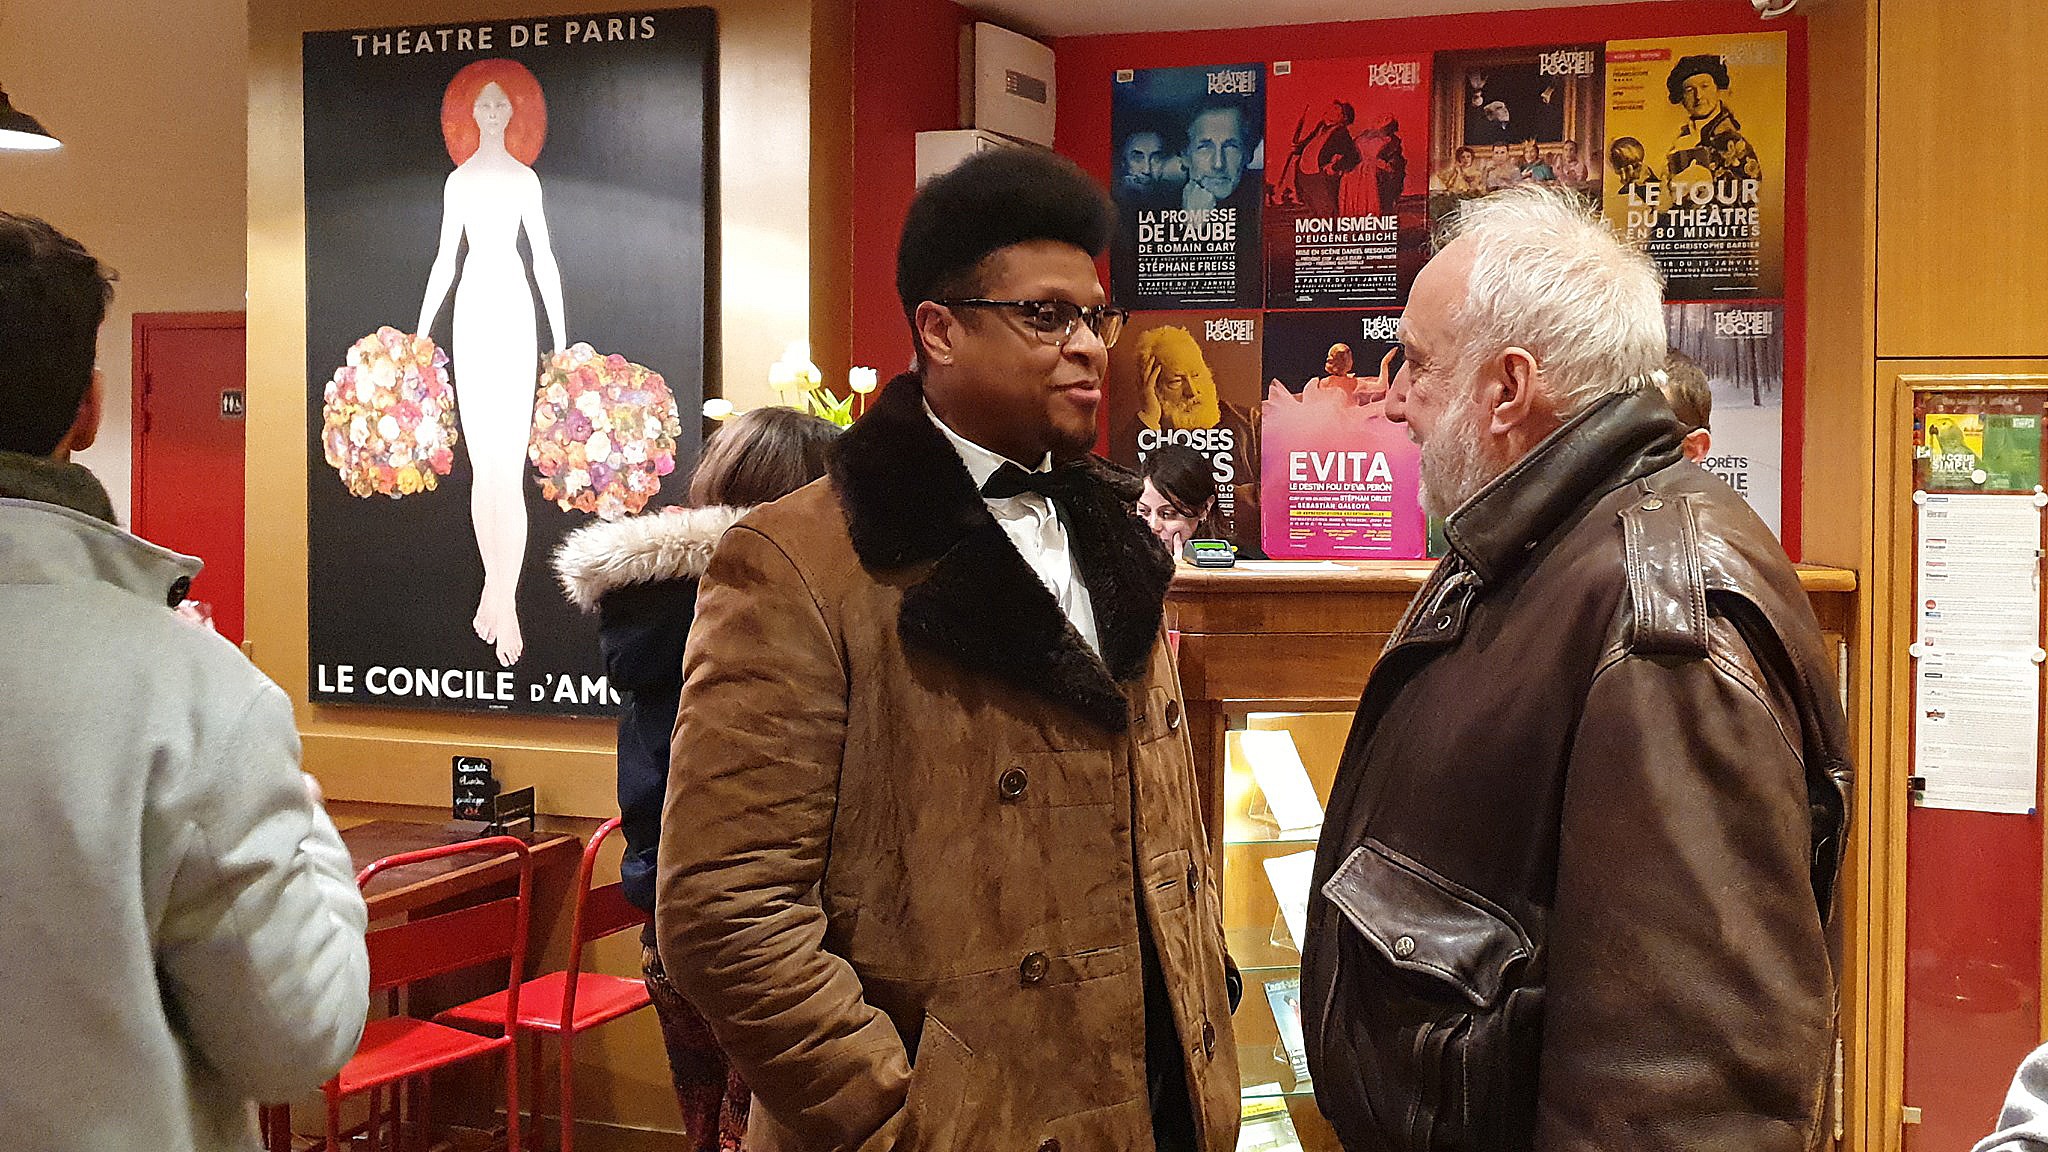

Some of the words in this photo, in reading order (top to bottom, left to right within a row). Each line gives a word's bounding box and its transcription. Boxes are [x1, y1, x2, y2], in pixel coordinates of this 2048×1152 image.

[510, 23, 549, 49] DE
[565, 16, 656, 45] PARIS
[1628, 182, 1660, 206] LE
[1671, 179, 1760, 206] TOUR
[1138, 211, 1155, 224] LA
[1161, 208, 1237, 223] PROMESSE
[1295, 218, 1333, 233] MON
[1336, 213, 1398, 231] ISMÉNIE
[1628, 210, 1658, 227] DU
[1138, 223, 1165, 243] DE
[1169, 221, 1236, 242] L'AUBE
[1295, 233, 1348, 243] D'EUGÈNE
[1352, 232, 1398, 242] LABICHE
[1627, 228, 1647, 239] EN
[1656, 227, 1675, 238] 80
[1683, 226, 1760, 238] MINUTES
[1138, 245, 1153, 254] DE
[1156, 243, 1202, 253] ROMAIN
[1206, 242, 1236, 252] GARY
[1138, 260, 1196, 273] STÉPHANE
[1197, 261, 1236, 271] FREISS
[1362, 315, 1401, 329] THÉÂTR
[1363, 327, 1400, 340] POCH
[1137, 428, 1235, 451] CHOSES
[1289, 451, 1393, 482] EVITA
[1932, 460, 1975, 471] SIMPLE
[1325, 483, 1342, 491] FOU
[318, 664, 353, 693] LE
[365, 666, 514, 700] CONCILE
